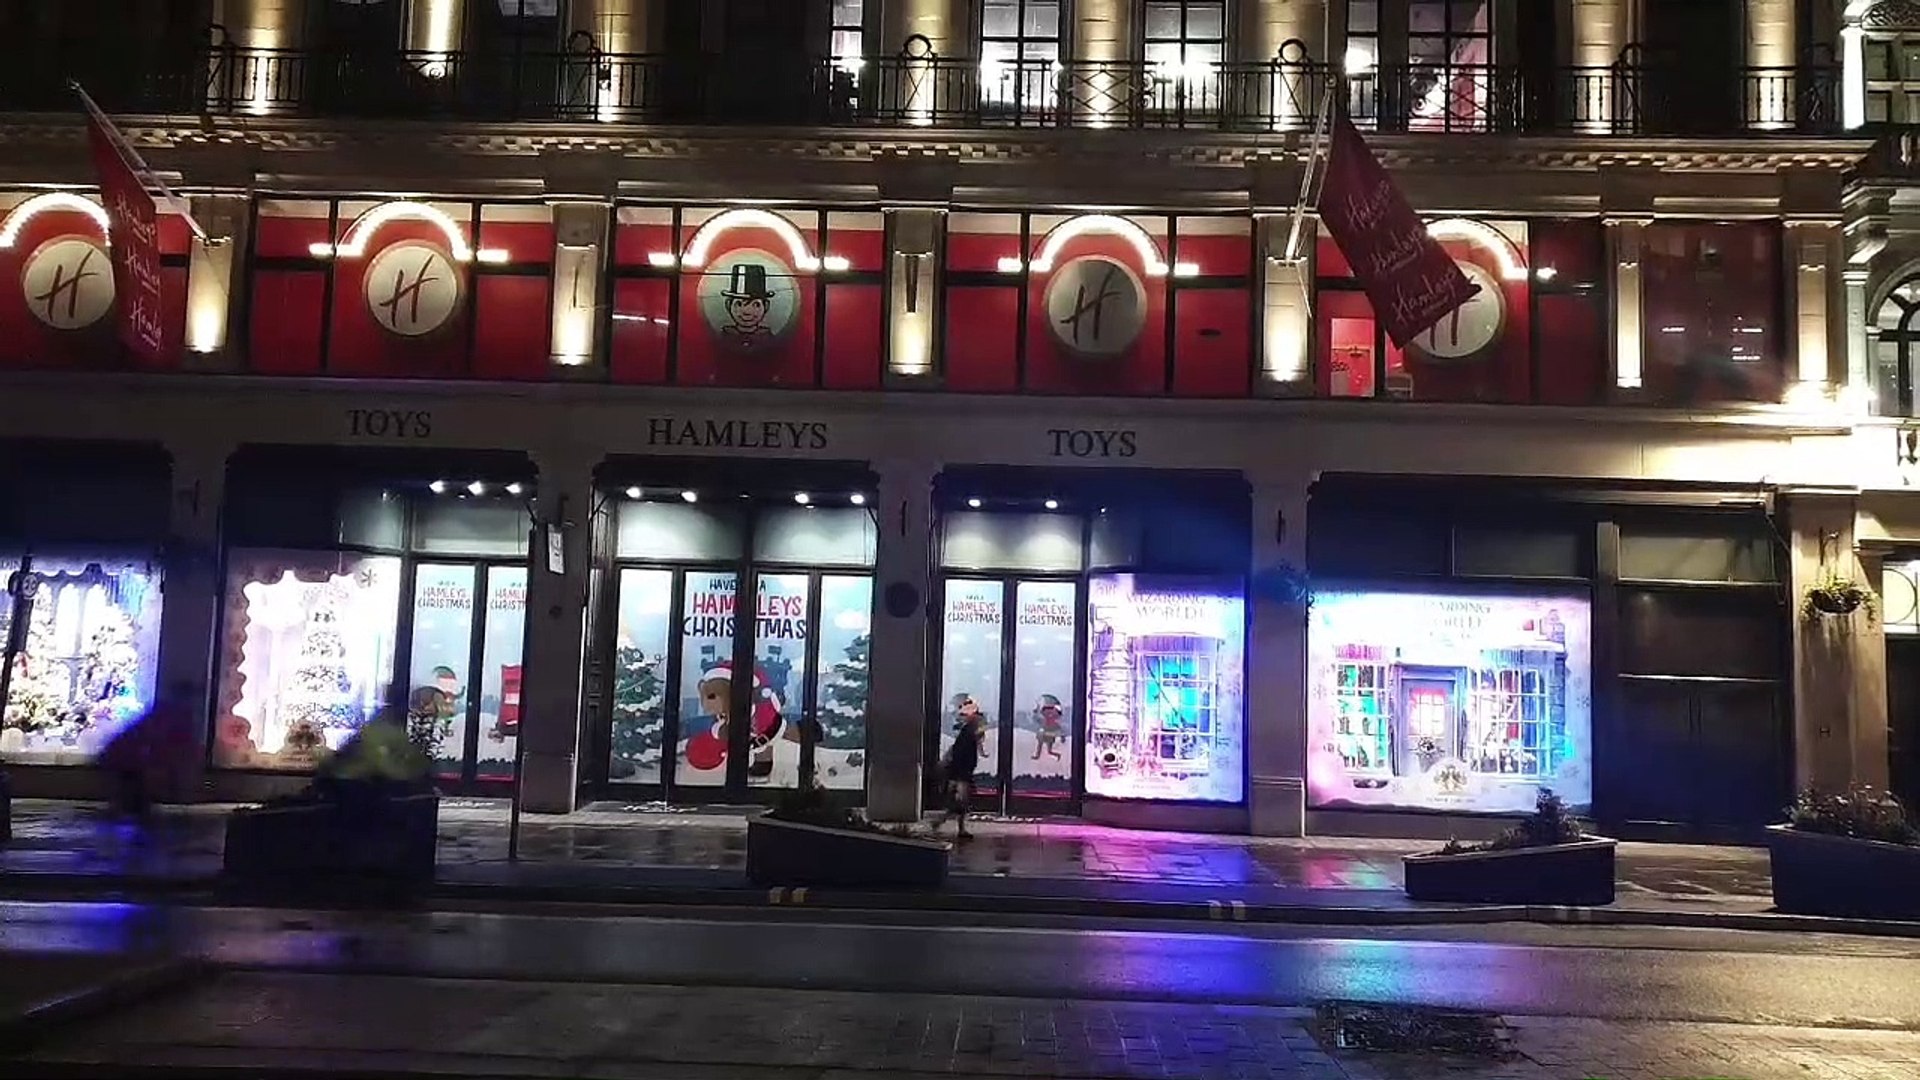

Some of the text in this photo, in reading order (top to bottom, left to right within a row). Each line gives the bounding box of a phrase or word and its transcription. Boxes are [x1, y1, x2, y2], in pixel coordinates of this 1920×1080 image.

[34, 248, 99, 321] H
[379, 254, 440, 327] H
[1060, 266, 1122, 345] H
[345, 409, 432, 438] TOYS
[648, 418, 828, 449] HAMLEYS
[1047, 429, 1137, 457] TOYS
[423, 586, 467, 599] HAMLEYS
[709, 578, 767, 593] HAVE A
[417, 599, 472, 610] CHRISTMAS
[952, 600, 997, 613] HAMLEYS
[1024, 602, 1069, 616] HAMLEYS
[946, 612, 1001, 624] CHRISTMAS
[1018, 614, 1073, 626] CHRISTMAS
